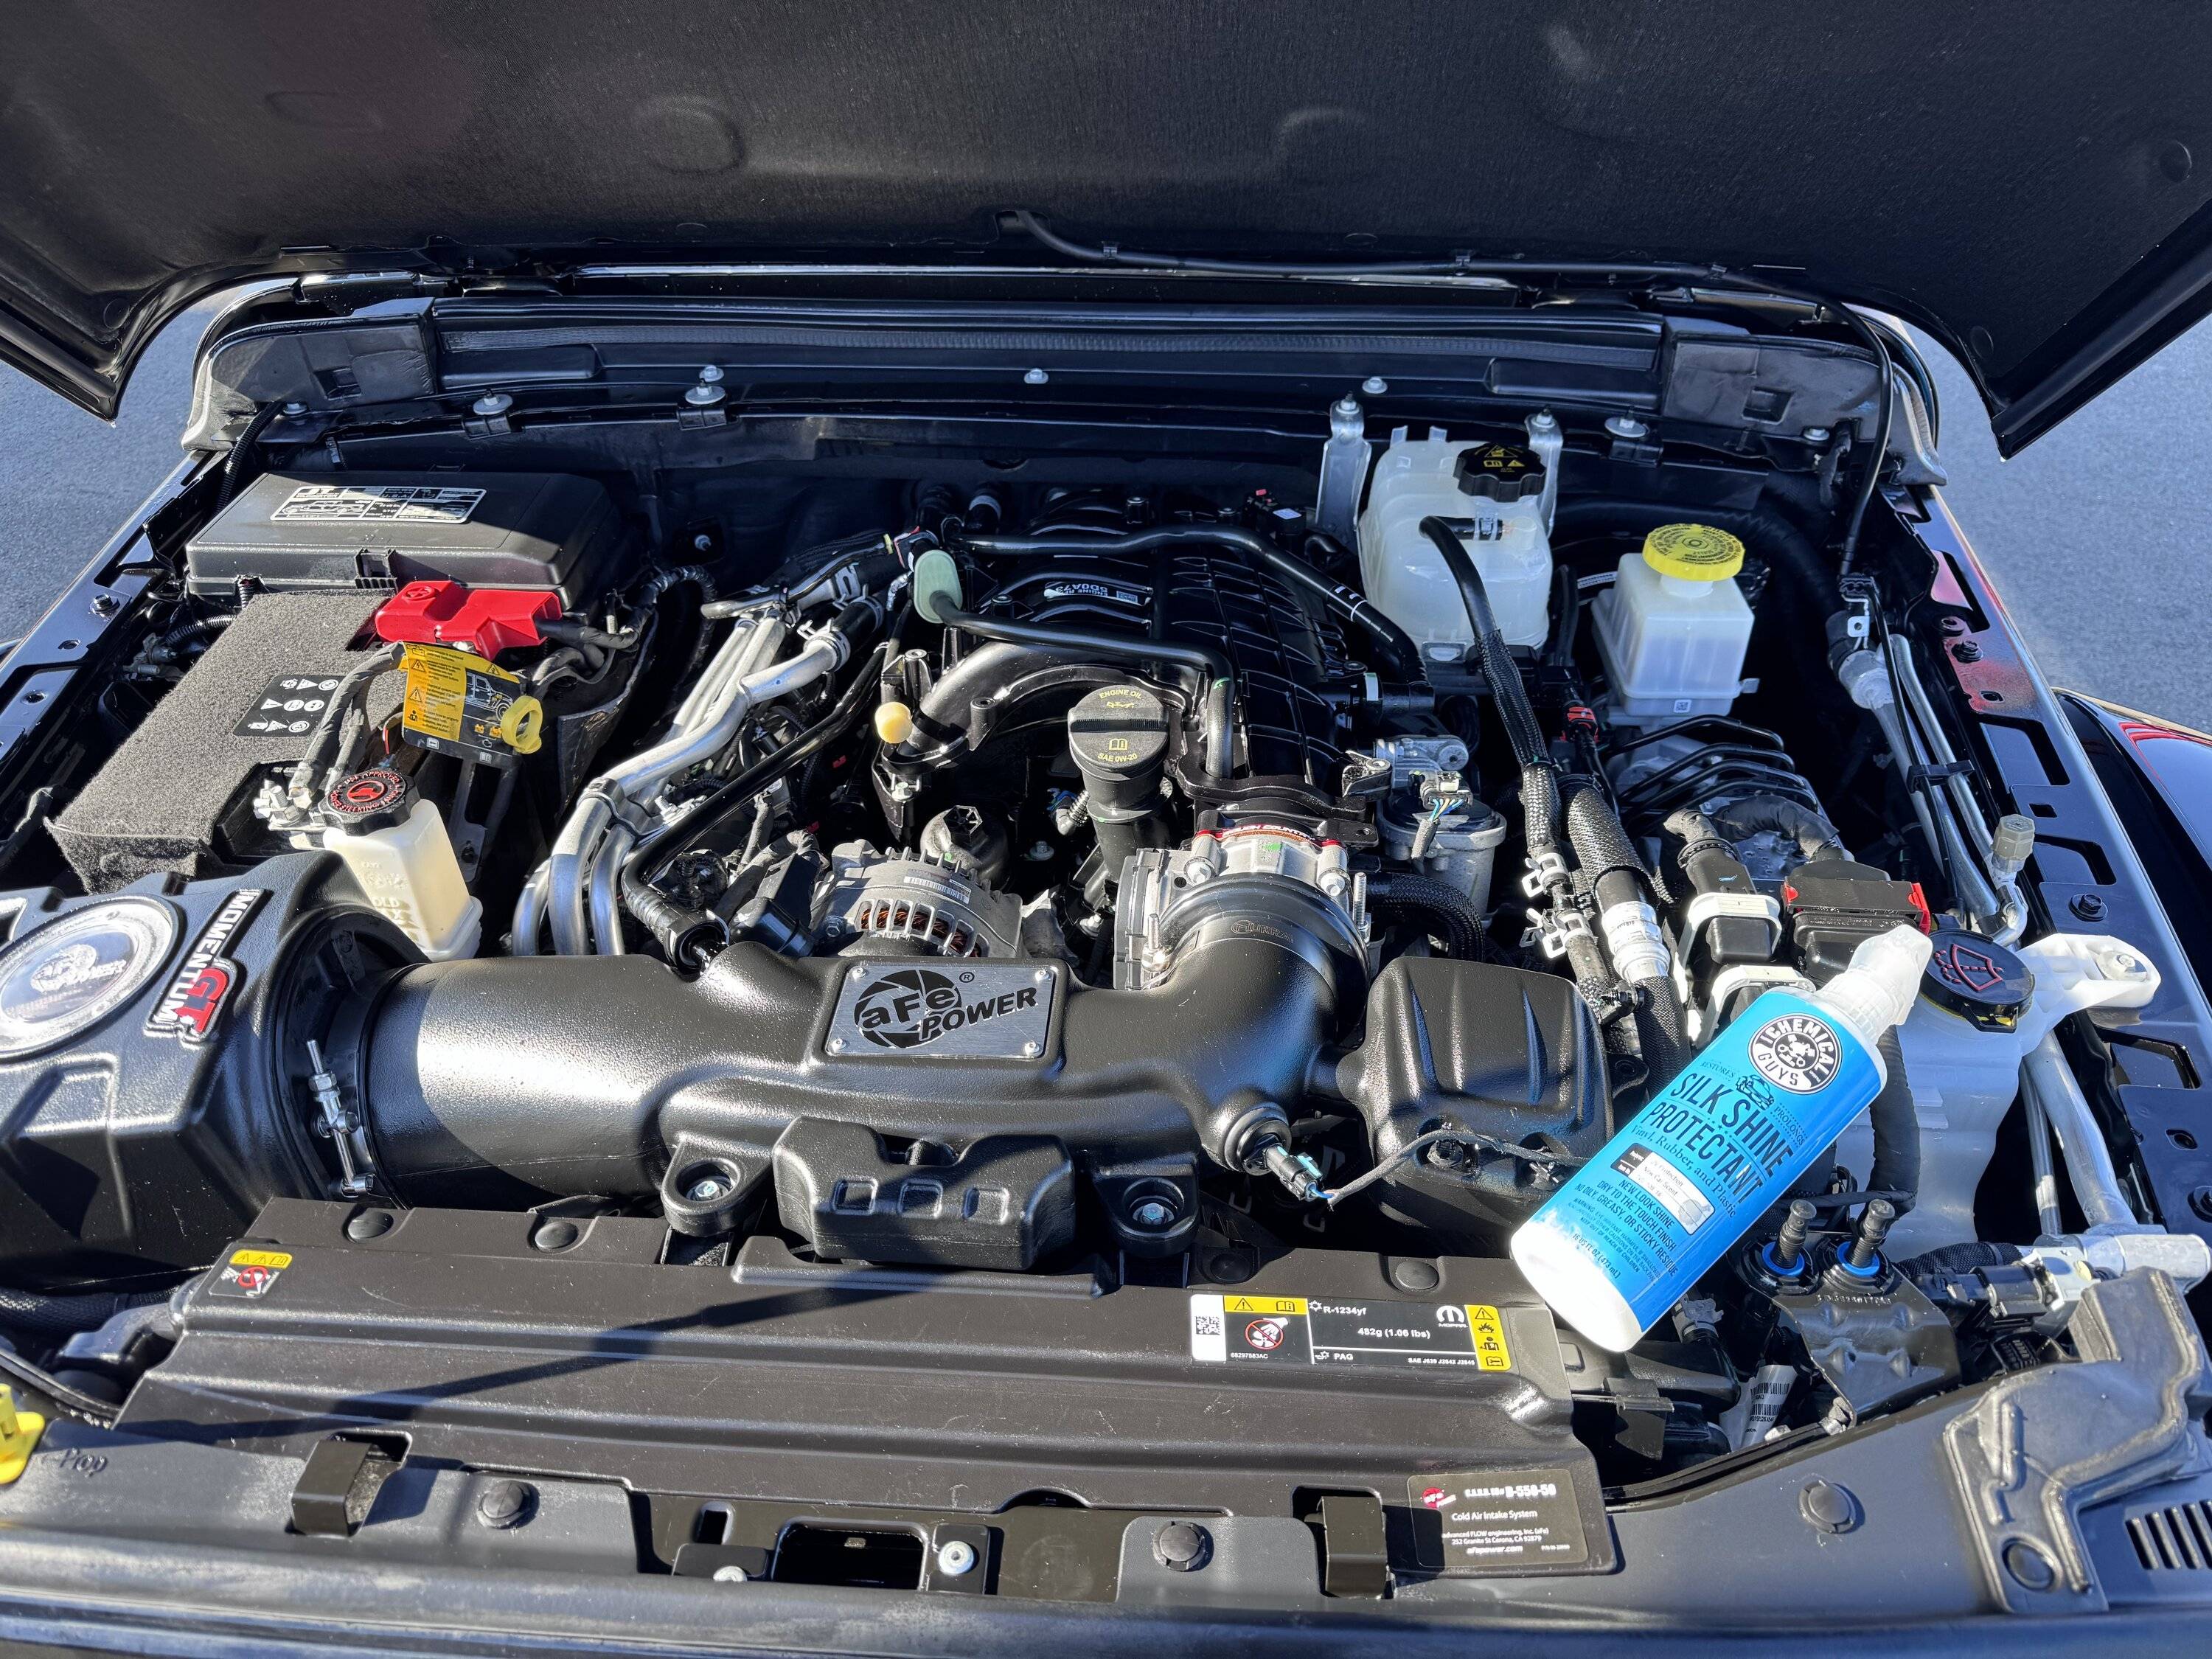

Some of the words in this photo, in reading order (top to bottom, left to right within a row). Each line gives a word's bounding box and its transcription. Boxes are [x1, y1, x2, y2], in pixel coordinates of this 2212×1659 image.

[1099, 689, 1129, 699] ENGINE
[1131, 689, 1143, 699] OIL
[1097, 752, 1113, 762] SAE
[1115, 753, 1138, 762] 0W-20
[361, 771, 400, 785] APPROVED
[153, 892, 257, 1024] MOMENTUM
[173, 967, 230, 1034] GT
[861, 988, 956, 1029] aFe
[922, 987, 1038, 1039] POWER
[1758, 1053, 1799, 1086] GUYS
[1670, 1073, 1734, 1115] SILK
[1722, 1099, 1794, 1178] SHINE
[1774, 1106, 1805, 1146] PROLONGS
[1641, 1102, 1763, 1203] PROTECTANT
[1655, 1135, 1694, 1171] Rubber,
[1694, 1168, 1716, 1187] and
[1712, 1182, 1736, 1217] Plastic
[1597, 1180, 1613, 1192] DRY
[1610, 1189, 1623, 1199] TO
[1621, 1194, 1638, 1211] THE
[1634, 1206, 1658, 1231] TOUCH
[1655, 1226, 1677, 1252] FINISH
[1618, 1180, 1636, 1194] NEW
[1635, 1190, 1656, 1211] LOOK
[1652, 1206, 1675, 1230] SHINE
[1596, 1194, 1626, 1220] GREASY,
[1624, 1215, 1637, 1228] OR
[1633, 1224, 1660, 1251] STICKY
[1655, 1247, 1679, 1277] RESIDUE
[1579, 1237, 1587, 1247] US
[1591, 1248, 1601, 1256] OZ
[1597, 1253, 1612, 1269] (473
[1609, 1267, 1621, 1279] mL)
[1323, 1306, 1367, 1316] R-1234yf
[1357, 1327, 1382, 1338] 482g
[1385, 1329, 1409, 1338] (1.06
[1411, 1329, 1431, 1339] lbs)
[1333, 1353, 1354, 1361] PAG
[1452, 1512, 1471, 1521] Cold
[1472, 1512, 1483, 1520] Air
[1484, 1510, 1508, 1520] Intake
[1509, 1509, 1538, 1520] System
